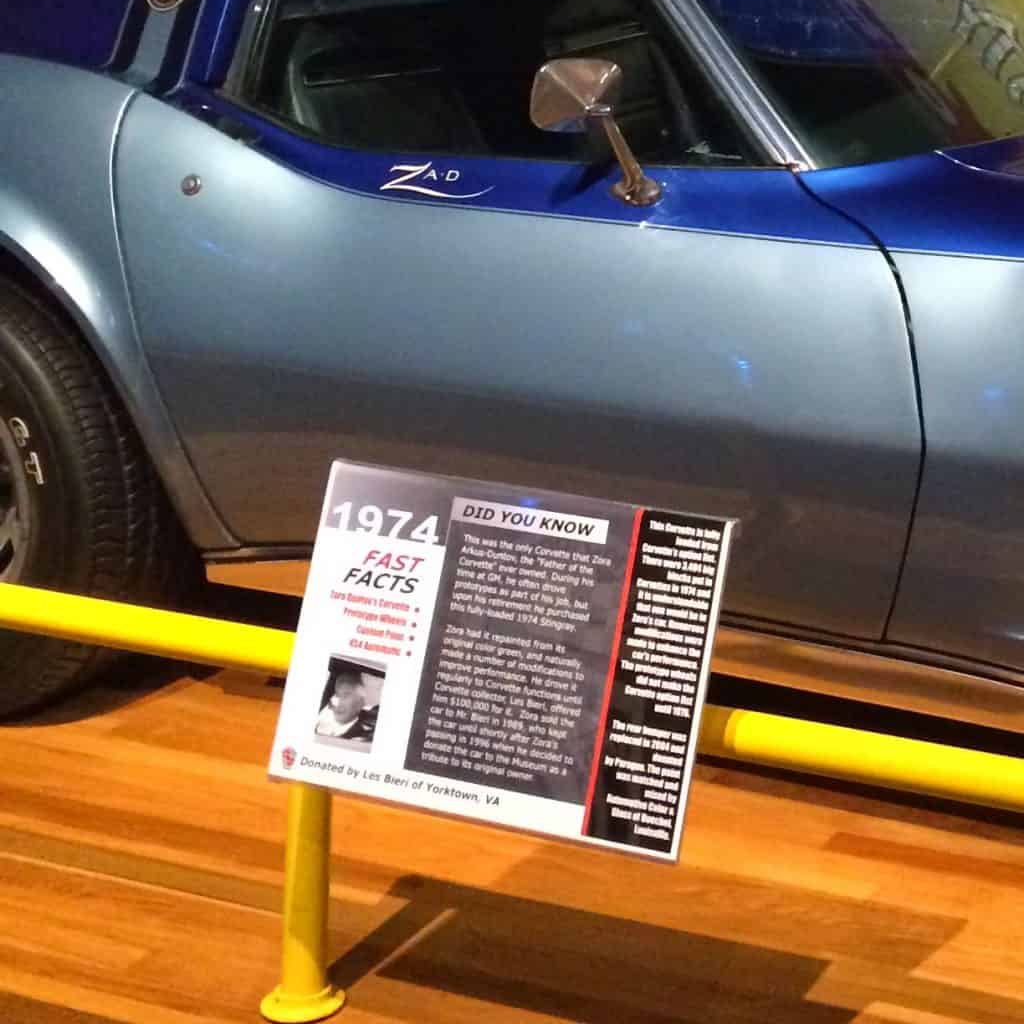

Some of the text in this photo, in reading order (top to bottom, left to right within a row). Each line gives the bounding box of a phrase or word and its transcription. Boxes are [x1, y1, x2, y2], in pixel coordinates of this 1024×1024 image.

[332, 501, 440, 544] 1974
[462, 504, 595, 537] DID YOU KNOW
[362, 549, 424, 573] FAST
[343, 567, 419, 594] FACTS
[299, 755, 345, 774] Donated
[345, 765, 361, 780] by
[362, 768, 381, 782] Les
[383, 773, 410, 788] Bieri
[410, 778, 424, 790] of
[485, 793, 500, 806] VA
